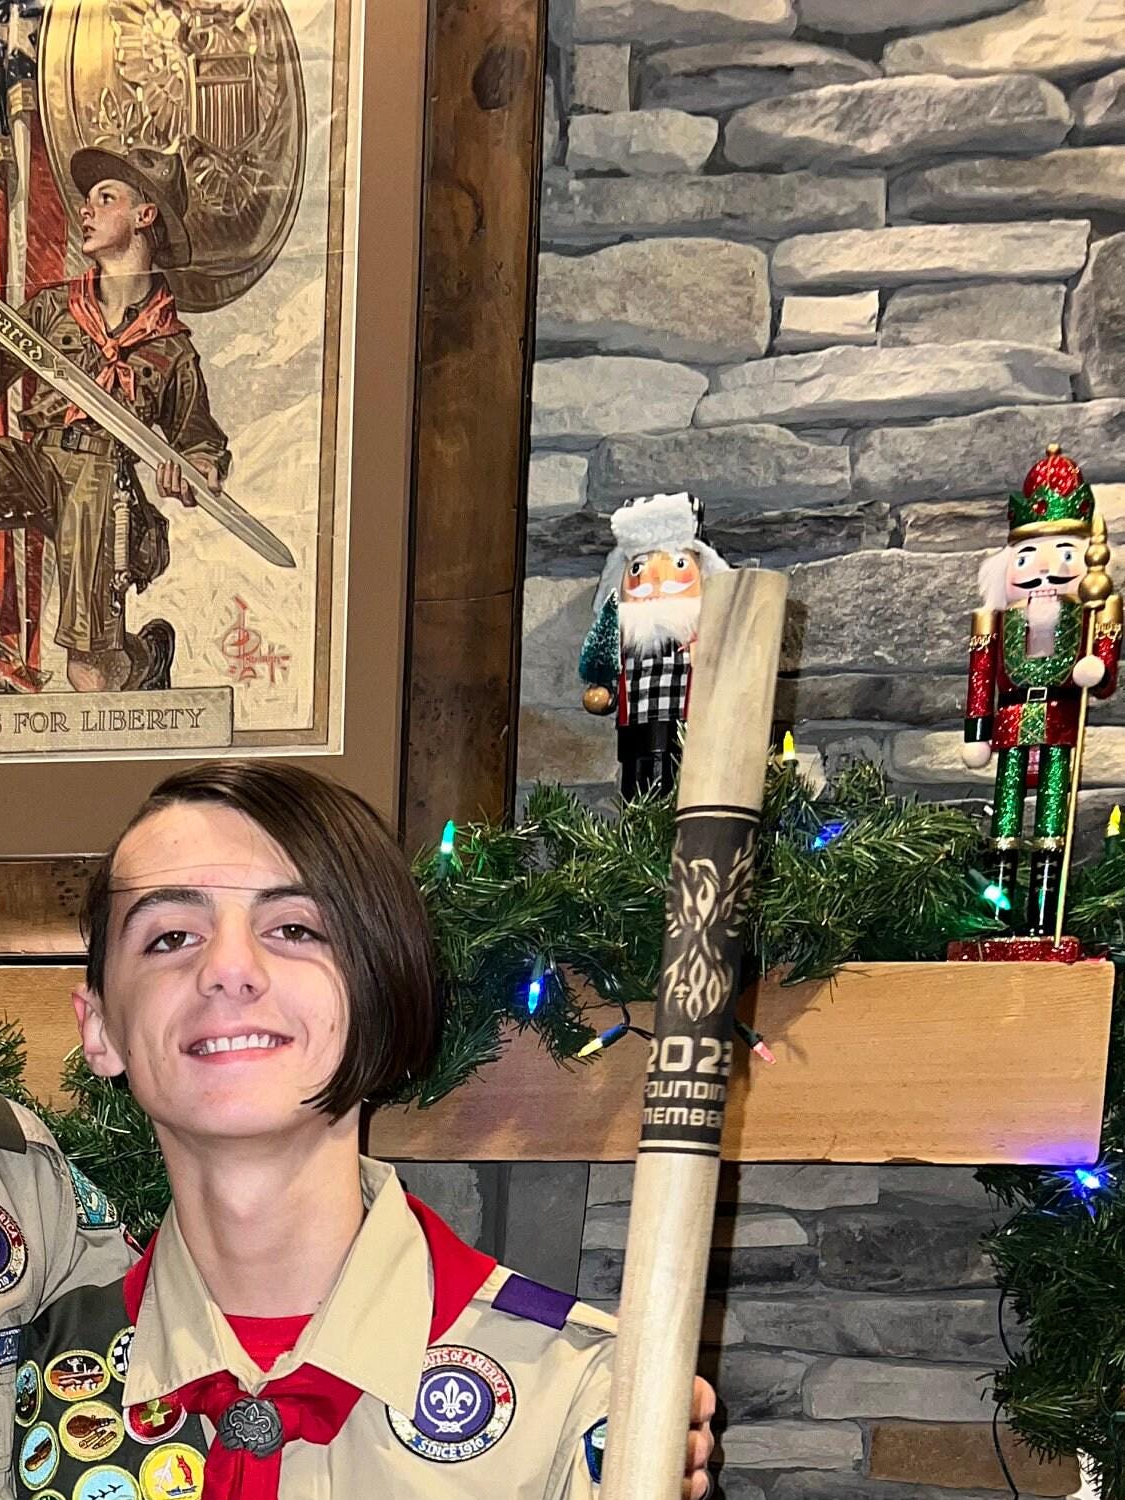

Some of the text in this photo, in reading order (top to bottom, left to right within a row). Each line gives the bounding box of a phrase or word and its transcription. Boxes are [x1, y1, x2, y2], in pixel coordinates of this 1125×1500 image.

[13, 711, 71, 734] FOR
[81, 707, 207, 732] LIBERTY
[462, 1353, 508, 1397] AMERICA
[418, 1437, 484, 1458] SINCE 1910
